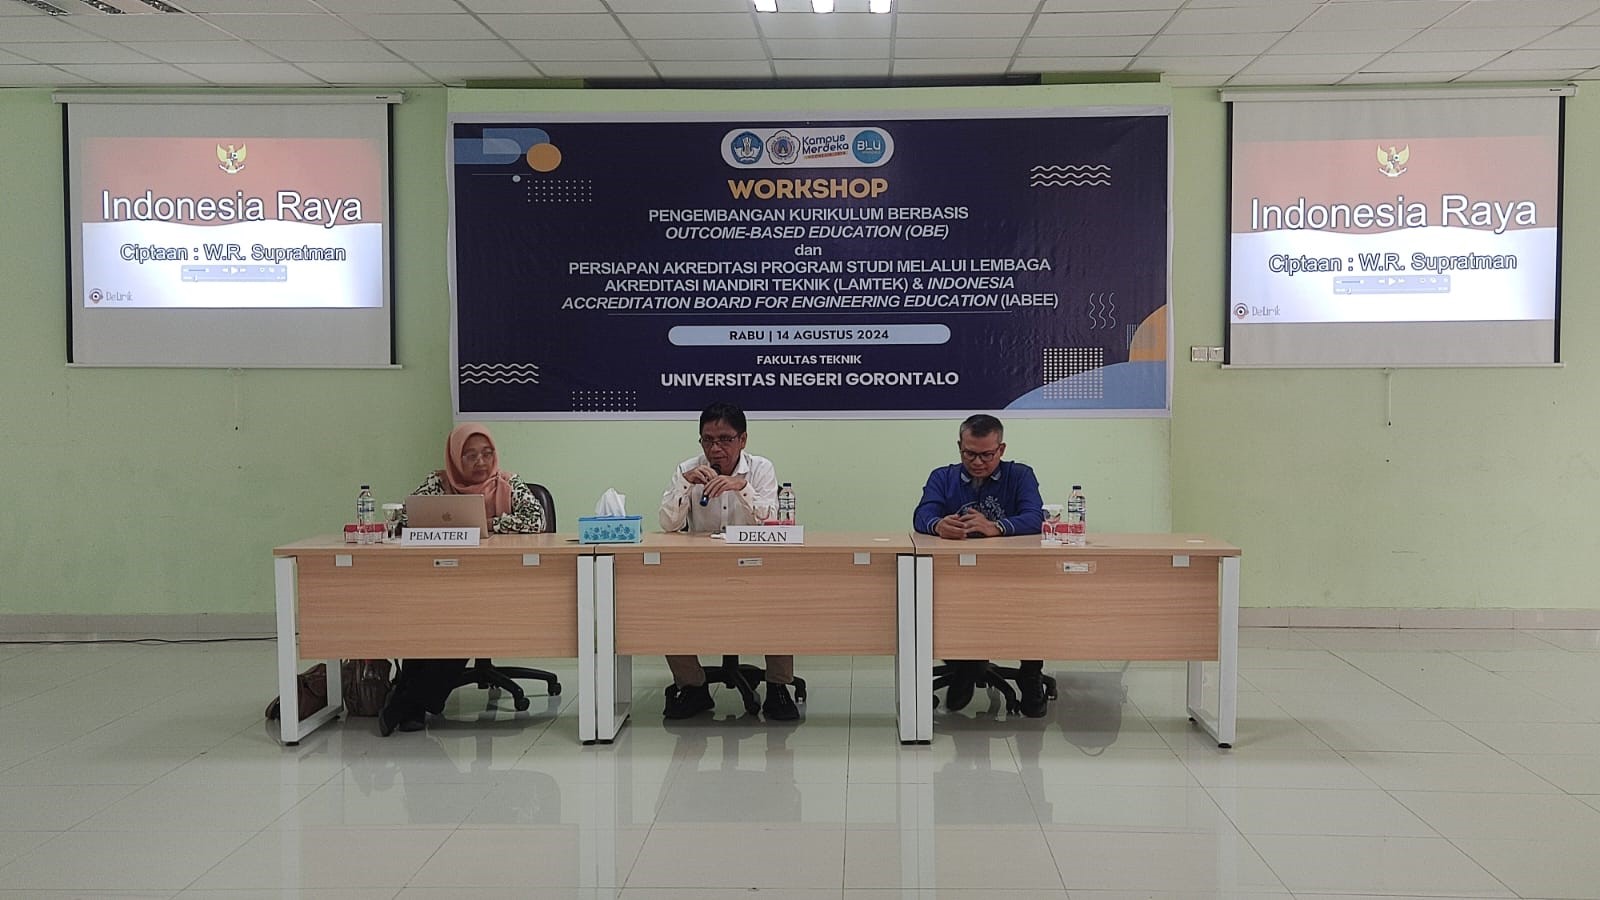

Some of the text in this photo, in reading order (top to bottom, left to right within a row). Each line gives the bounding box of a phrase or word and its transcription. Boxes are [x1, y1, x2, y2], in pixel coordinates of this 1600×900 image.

[802, 134, 846, 146] Kampus
[857, 140, 881, 151] BLU
[802, 143, 849, 155] Merdeka
[727, 178, 889, 200] WORKSHOP
[101, 189, 363, 229] Indonesia Raya
[648, 206, 969, 222] PENGEMBANGAN KURIKULUM BERBASIS
[1250, 193, 1538, 234] Indonesia Raya
[665, 223, 950, 241] OUTCOME-BASED EDUCATION (OBE)
[120, 243, 188, 264] Ciptaan
[203, 243, 246, 261] W.R.
[251, 244, 346, 264] Supratman
[794, 243, 823, 256] dan
[568, 258, 1051, 275] PERSIAPAN AKREDITASI PROGRAM STUDI MELALUI LEMBAGA
[1268, 254, 1342, 276] Ciptaan
[1359, 253, 1405, 271] W.R.
[1411, 252, 1517, 274] Supratman
[604, 276, 1015, 294] AKREDITASI MANDIRI TEKNIK (LAMTEK) & INDONESIA
[561, 293, 1059, 310] ACCREDITATION BOARD FOR ENGINEERING EDUCATION (IABEE)
[729, 330, 765, 341] RABU
[777, 330, 790, 341] 14
[793, 330, 854, 340] AGUSTUS
[856, 329, 889, 340] 2024
[756, 354, 862, 365] FAKULTAS TEKNIK
[660, 371, 959, 387] UNIVERSITAS NEGERI GORONTALO
[409, 530, 469, 542] PEMATERI
[738, 530, 788, 542] DEKAN
